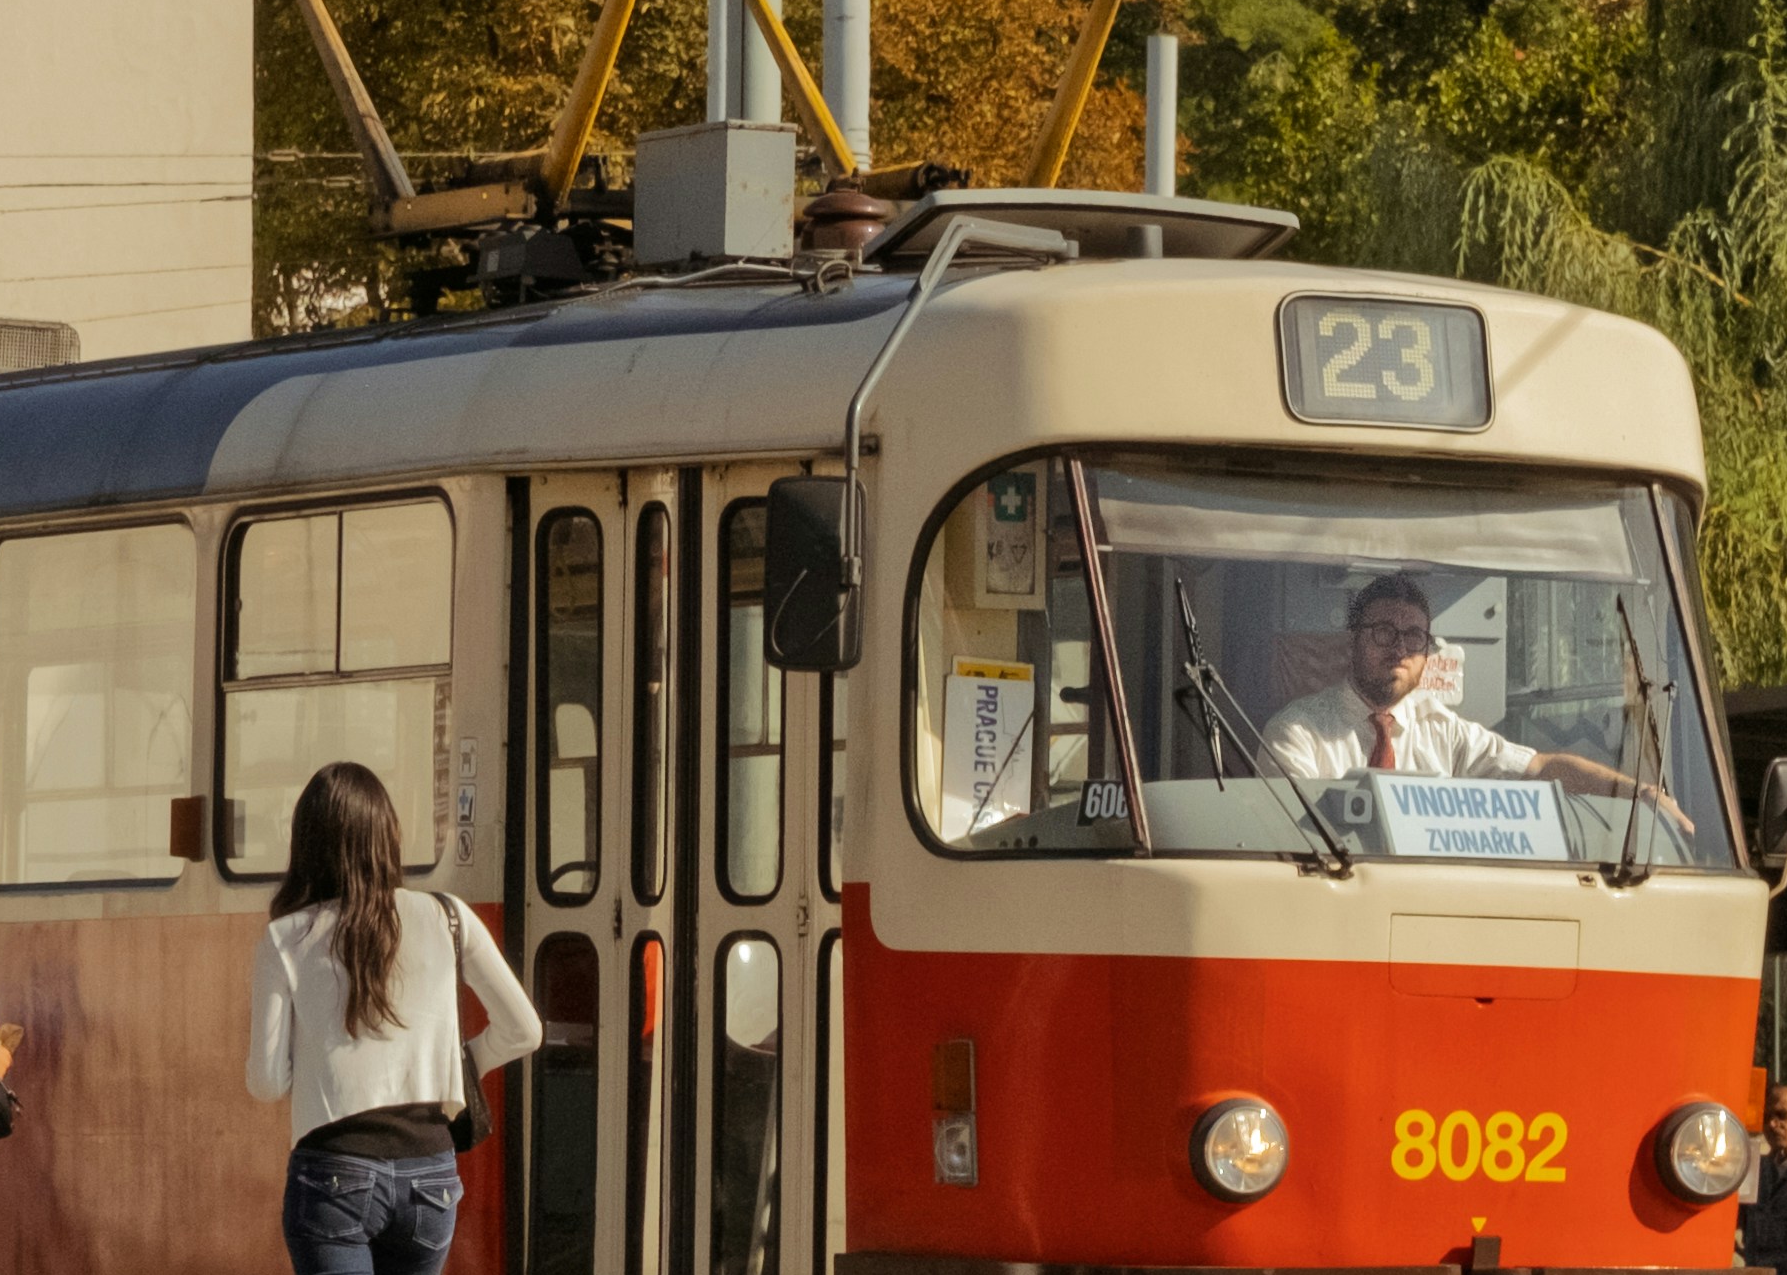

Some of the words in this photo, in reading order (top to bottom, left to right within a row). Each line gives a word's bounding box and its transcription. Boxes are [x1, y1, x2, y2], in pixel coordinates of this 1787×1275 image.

[1318, 308, 1434, 401] 23
[973, 684, 999, 773] PRAGUE
[1390, 784, 1541, 820] VINOHRADY
[1425, 826, 1535, 855] ZVONAŘKA
[1391, 1108, 1568, 1183] 8082
